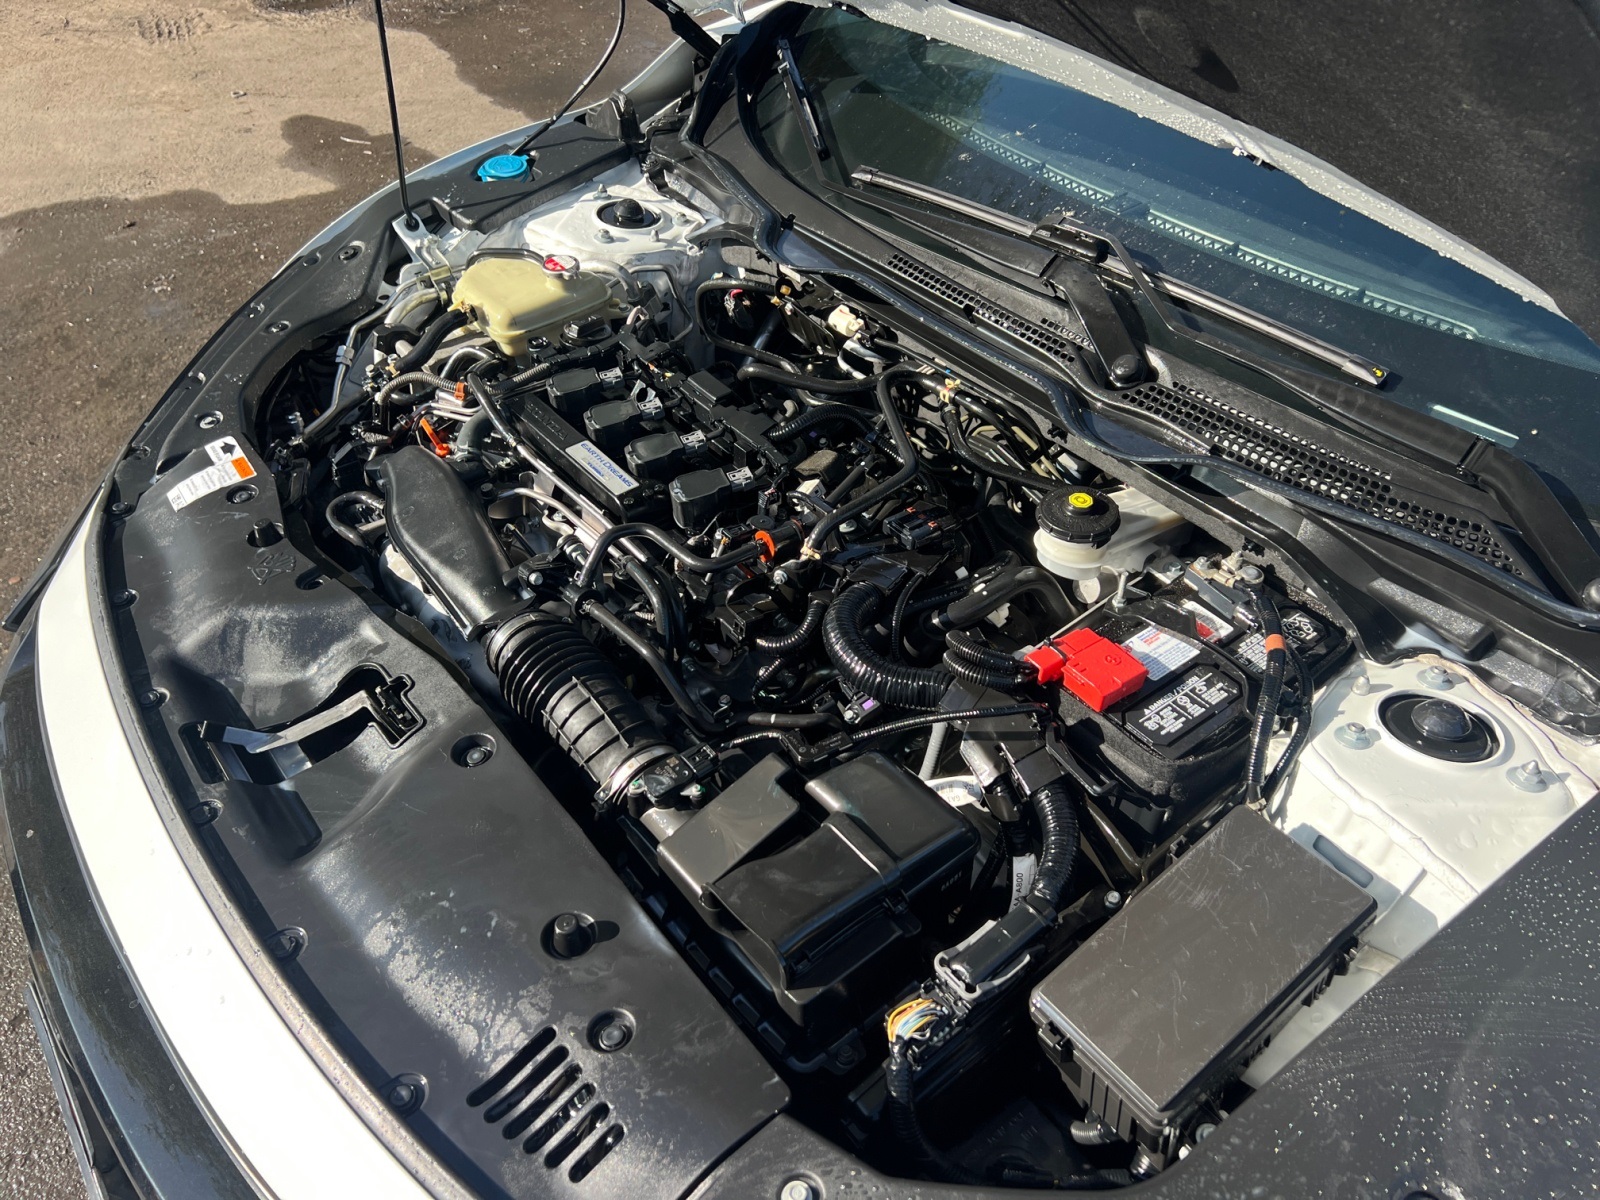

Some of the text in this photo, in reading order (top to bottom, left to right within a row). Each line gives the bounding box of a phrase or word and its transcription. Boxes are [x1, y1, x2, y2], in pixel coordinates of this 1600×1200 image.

[580, 442, 605, 463] EARTH
[602, 461, 634, 487] DREAMS
[1148, 692, 1174, 710] DANGER
[1177, 675, 1200, 693] POISON
